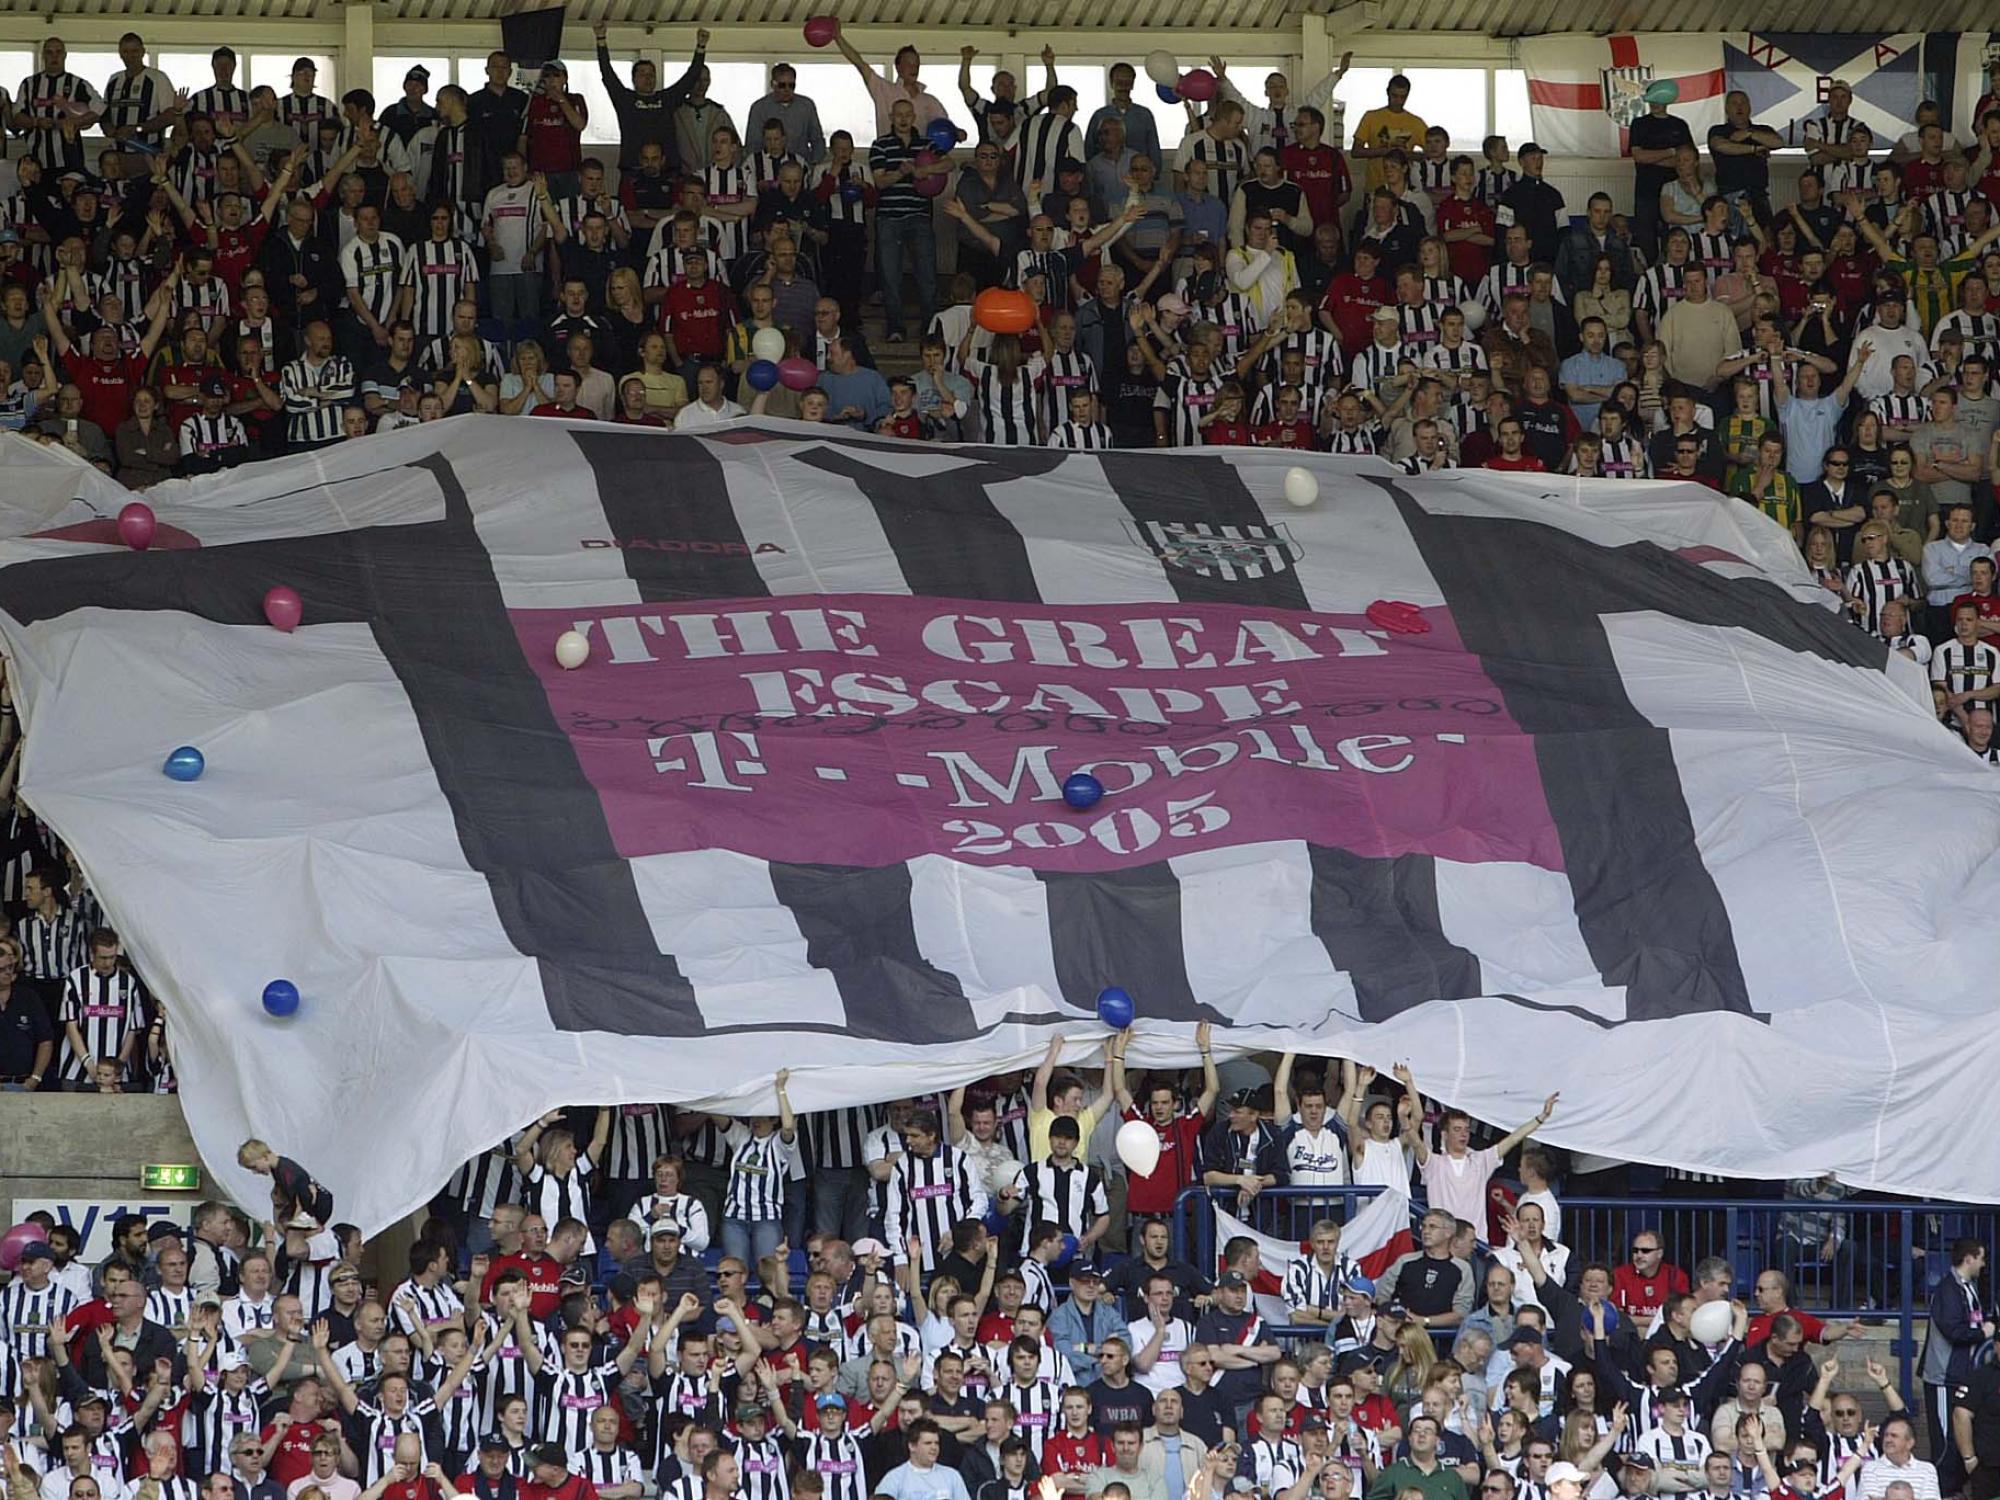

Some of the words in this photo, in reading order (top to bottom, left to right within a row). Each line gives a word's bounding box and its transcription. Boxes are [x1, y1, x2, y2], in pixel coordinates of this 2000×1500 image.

[581, 538, 786, 554] DIADORA
[573, 608, 880, 665] THE
[921, 613, 1391, 670] GREAT
[740, 668, 1304, 725] ESCAPE
[942, 790, 1232, 855] 2005
[1107, 1407, 1139, 1421] WBA
